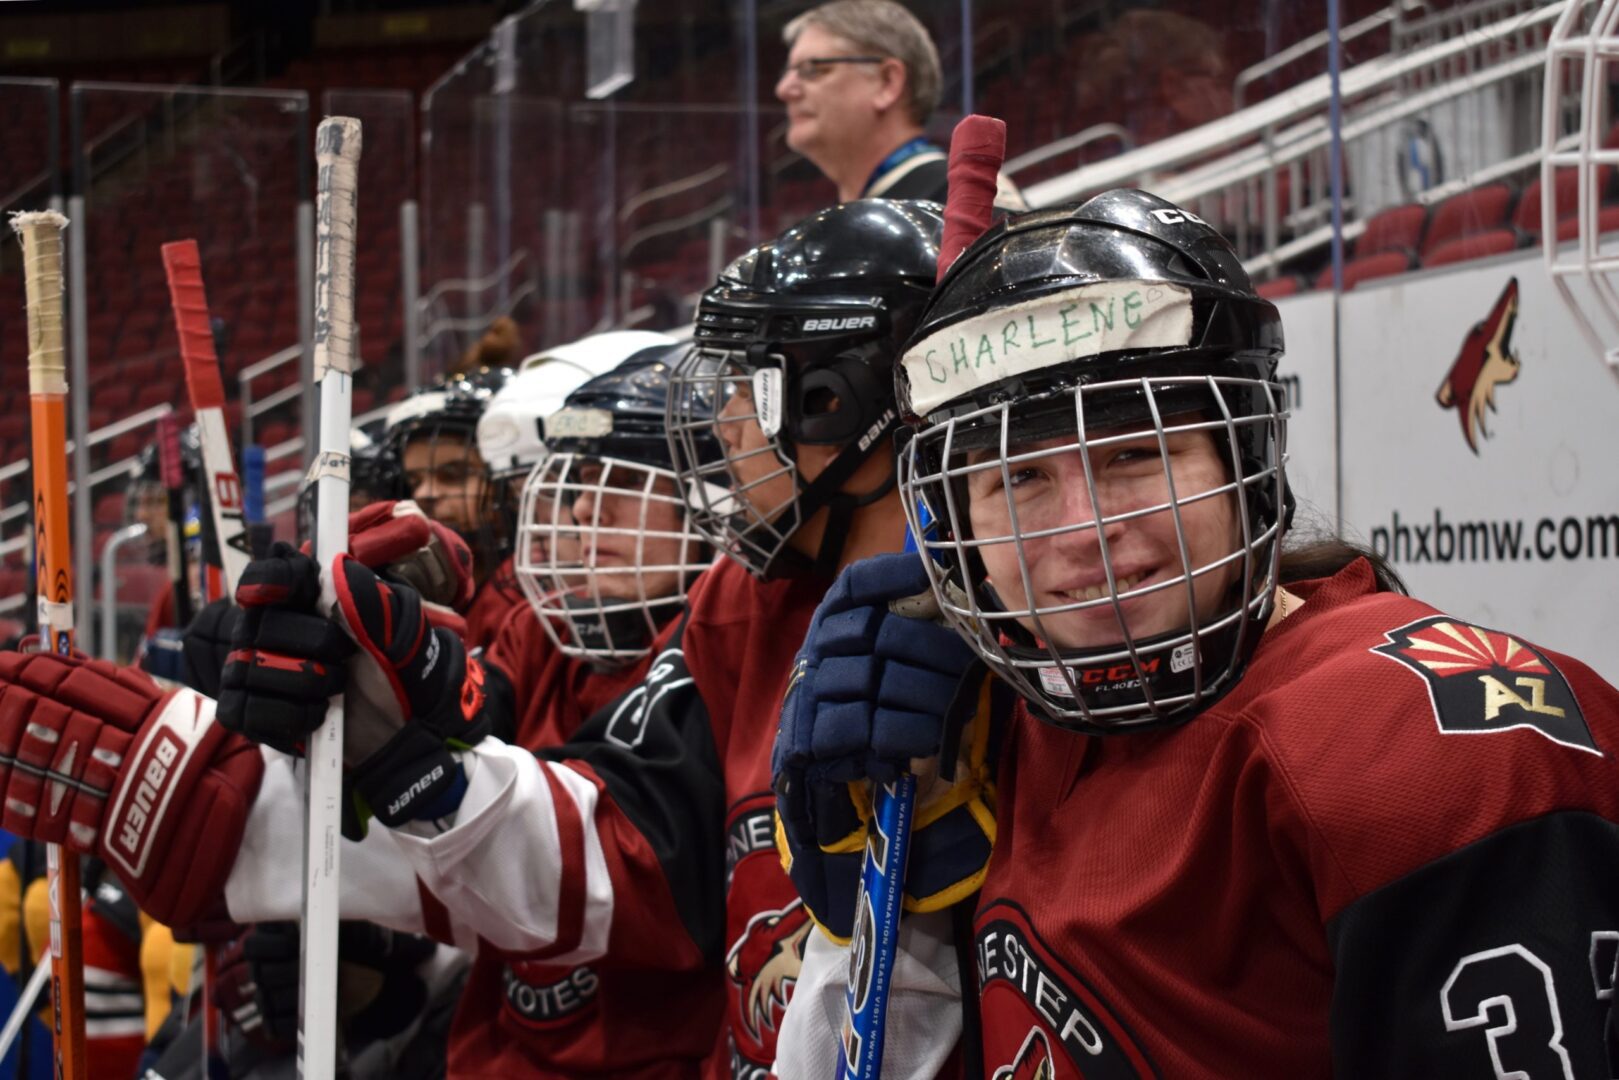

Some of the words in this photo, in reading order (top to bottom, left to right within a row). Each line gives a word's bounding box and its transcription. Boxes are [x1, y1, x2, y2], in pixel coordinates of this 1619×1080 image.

[803, 315, 876, 332] BAUER
[925, 290, 1144, 384] CHARLENE
[1371, 507, 1619, 563] phxbmw.com
[1082, 658, 1160, 684] CCM
[1478, 675, 1565, 720] AZ
[120, 736, 178, 854] BAUER
[388, 765, 444, 817] BAUER
[893, 803, 907, 864] WARRANTY
[883, 868, 898, 945] INFORMATION
[876, 949, 888, 992] PLEASE
[1003, 933, 1103, 1056] STEP
[872, 996, 882, 1026] VISIT
